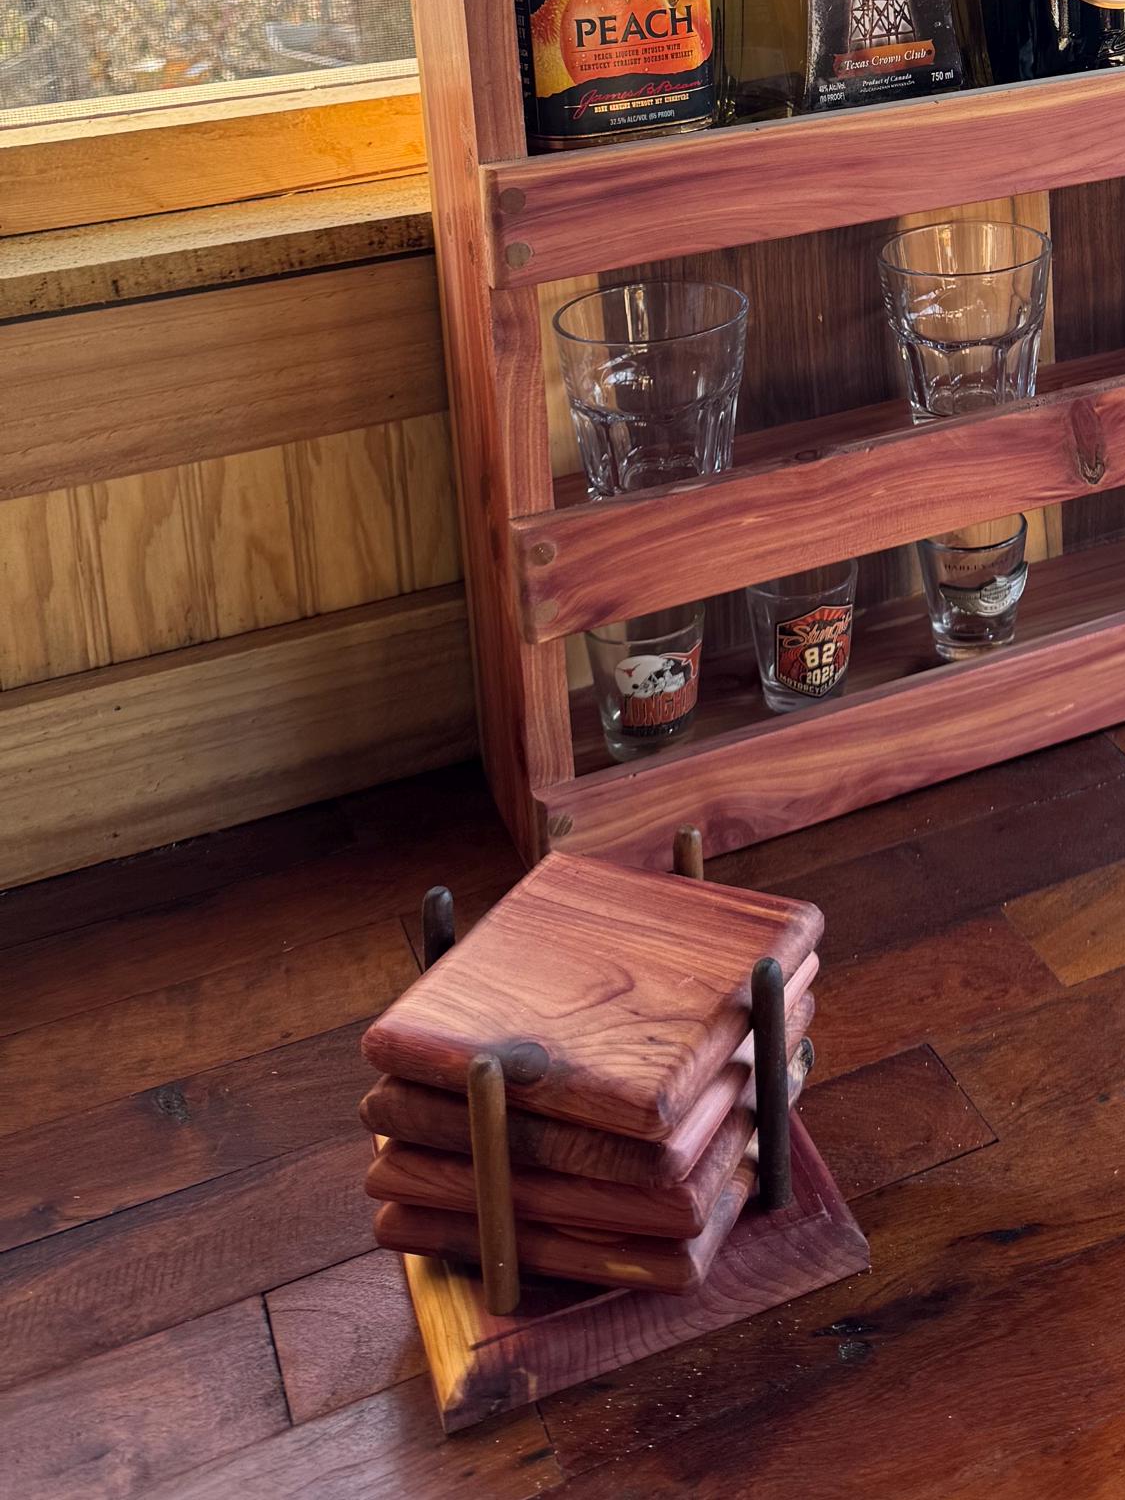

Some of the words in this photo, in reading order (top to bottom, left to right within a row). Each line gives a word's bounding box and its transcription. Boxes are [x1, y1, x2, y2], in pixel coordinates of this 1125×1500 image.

[574, 5, 694, 48] PEACH
[844, 60, 869, 71] Texas
[871, 54, 901, 66] Crown
[904, 48, 927, 61] Club
[862, 78, 883, 88] Product
[890, 73, 912, 82] Canada
[931, 71, 944, 82] 750
[945, 70, 954, 79] ml
[657, 109, 675, 120] PROOF)
[780, 673, 834, 694] MOTORCYCLE
[806, 664, 835, 685] 2022
